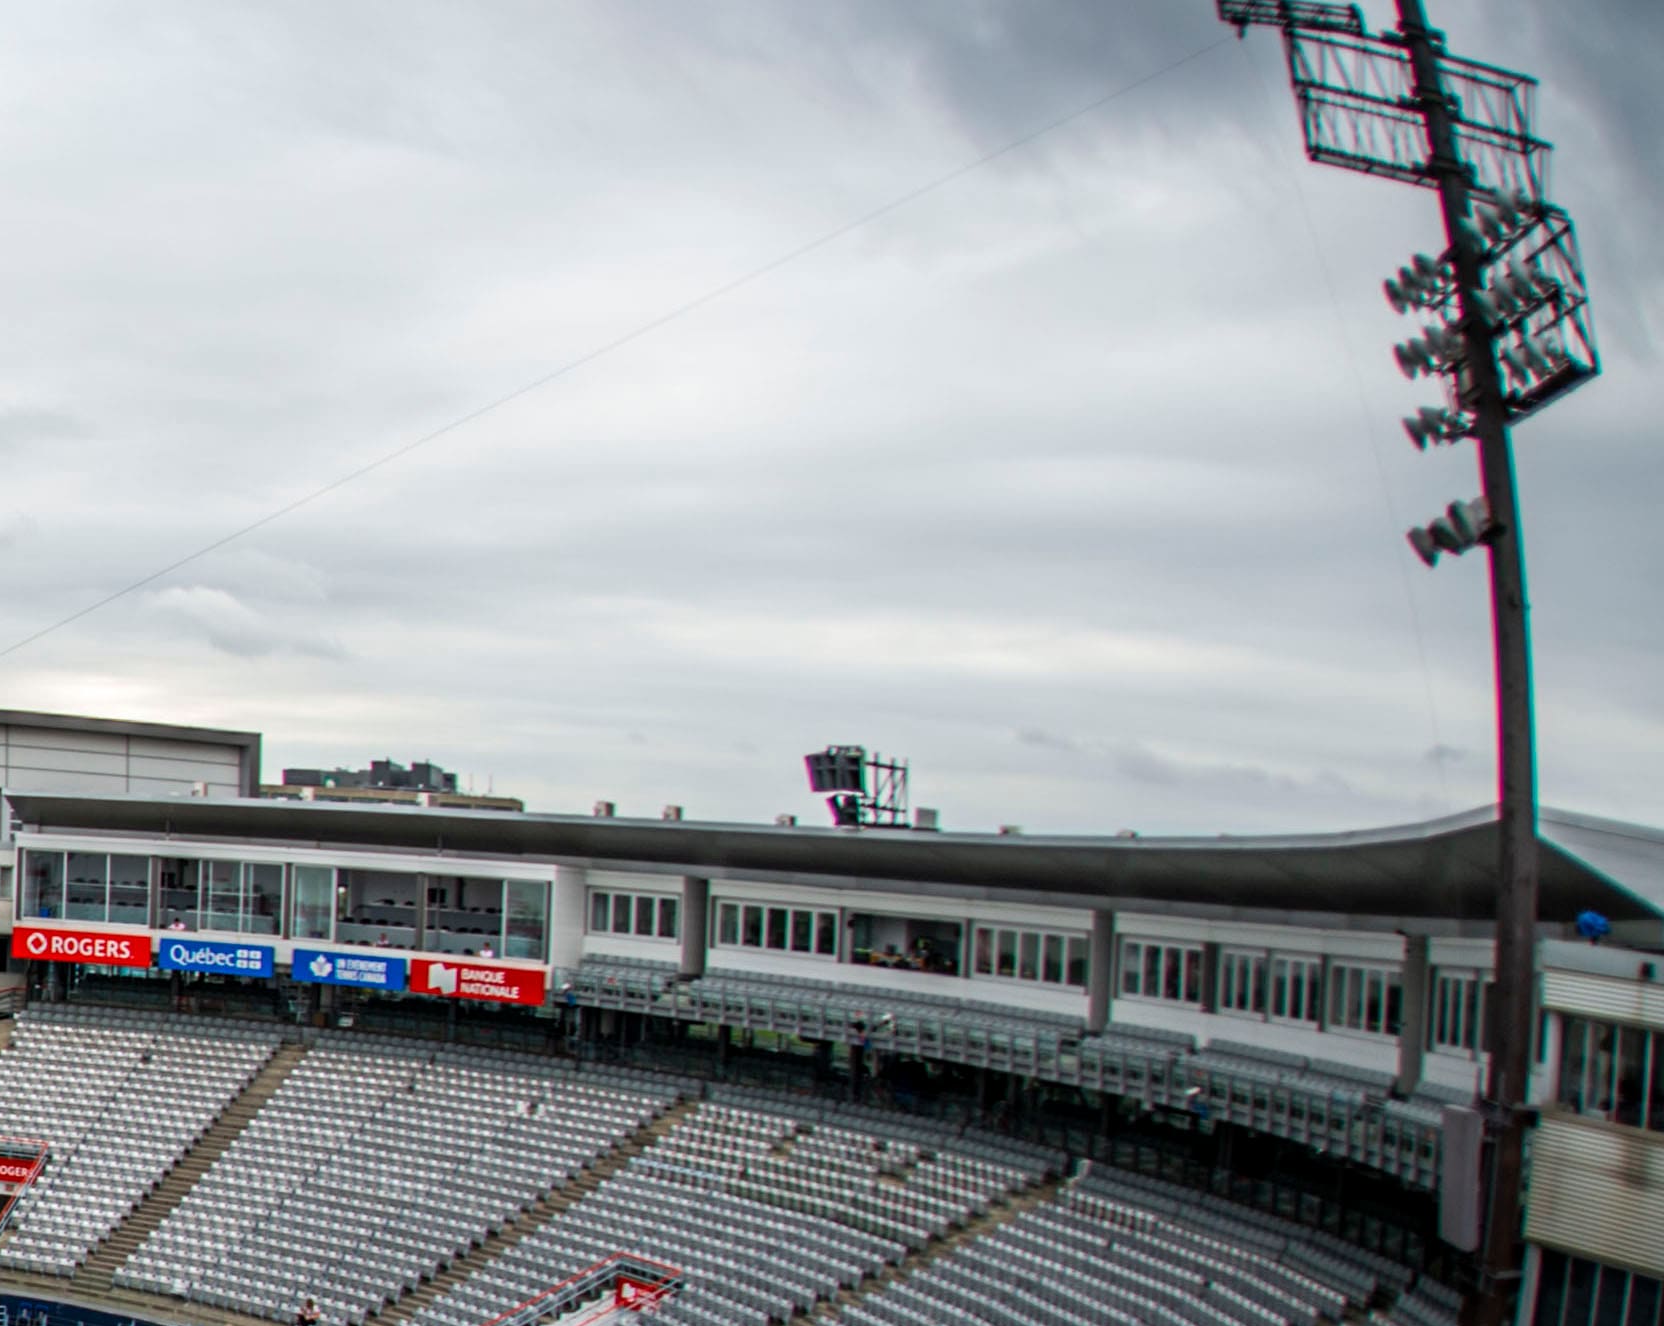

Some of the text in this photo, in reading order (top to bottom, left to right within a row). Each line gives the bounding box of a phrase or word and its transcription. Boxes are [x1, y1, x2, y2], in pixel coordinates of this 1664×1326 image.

[52, 936, 131, 958] ROGERS
[170, 945, 235, 966] Québec
[460, 968, 505, 984] BANQUE
[460, 982, 520, 999] NATIONALE
